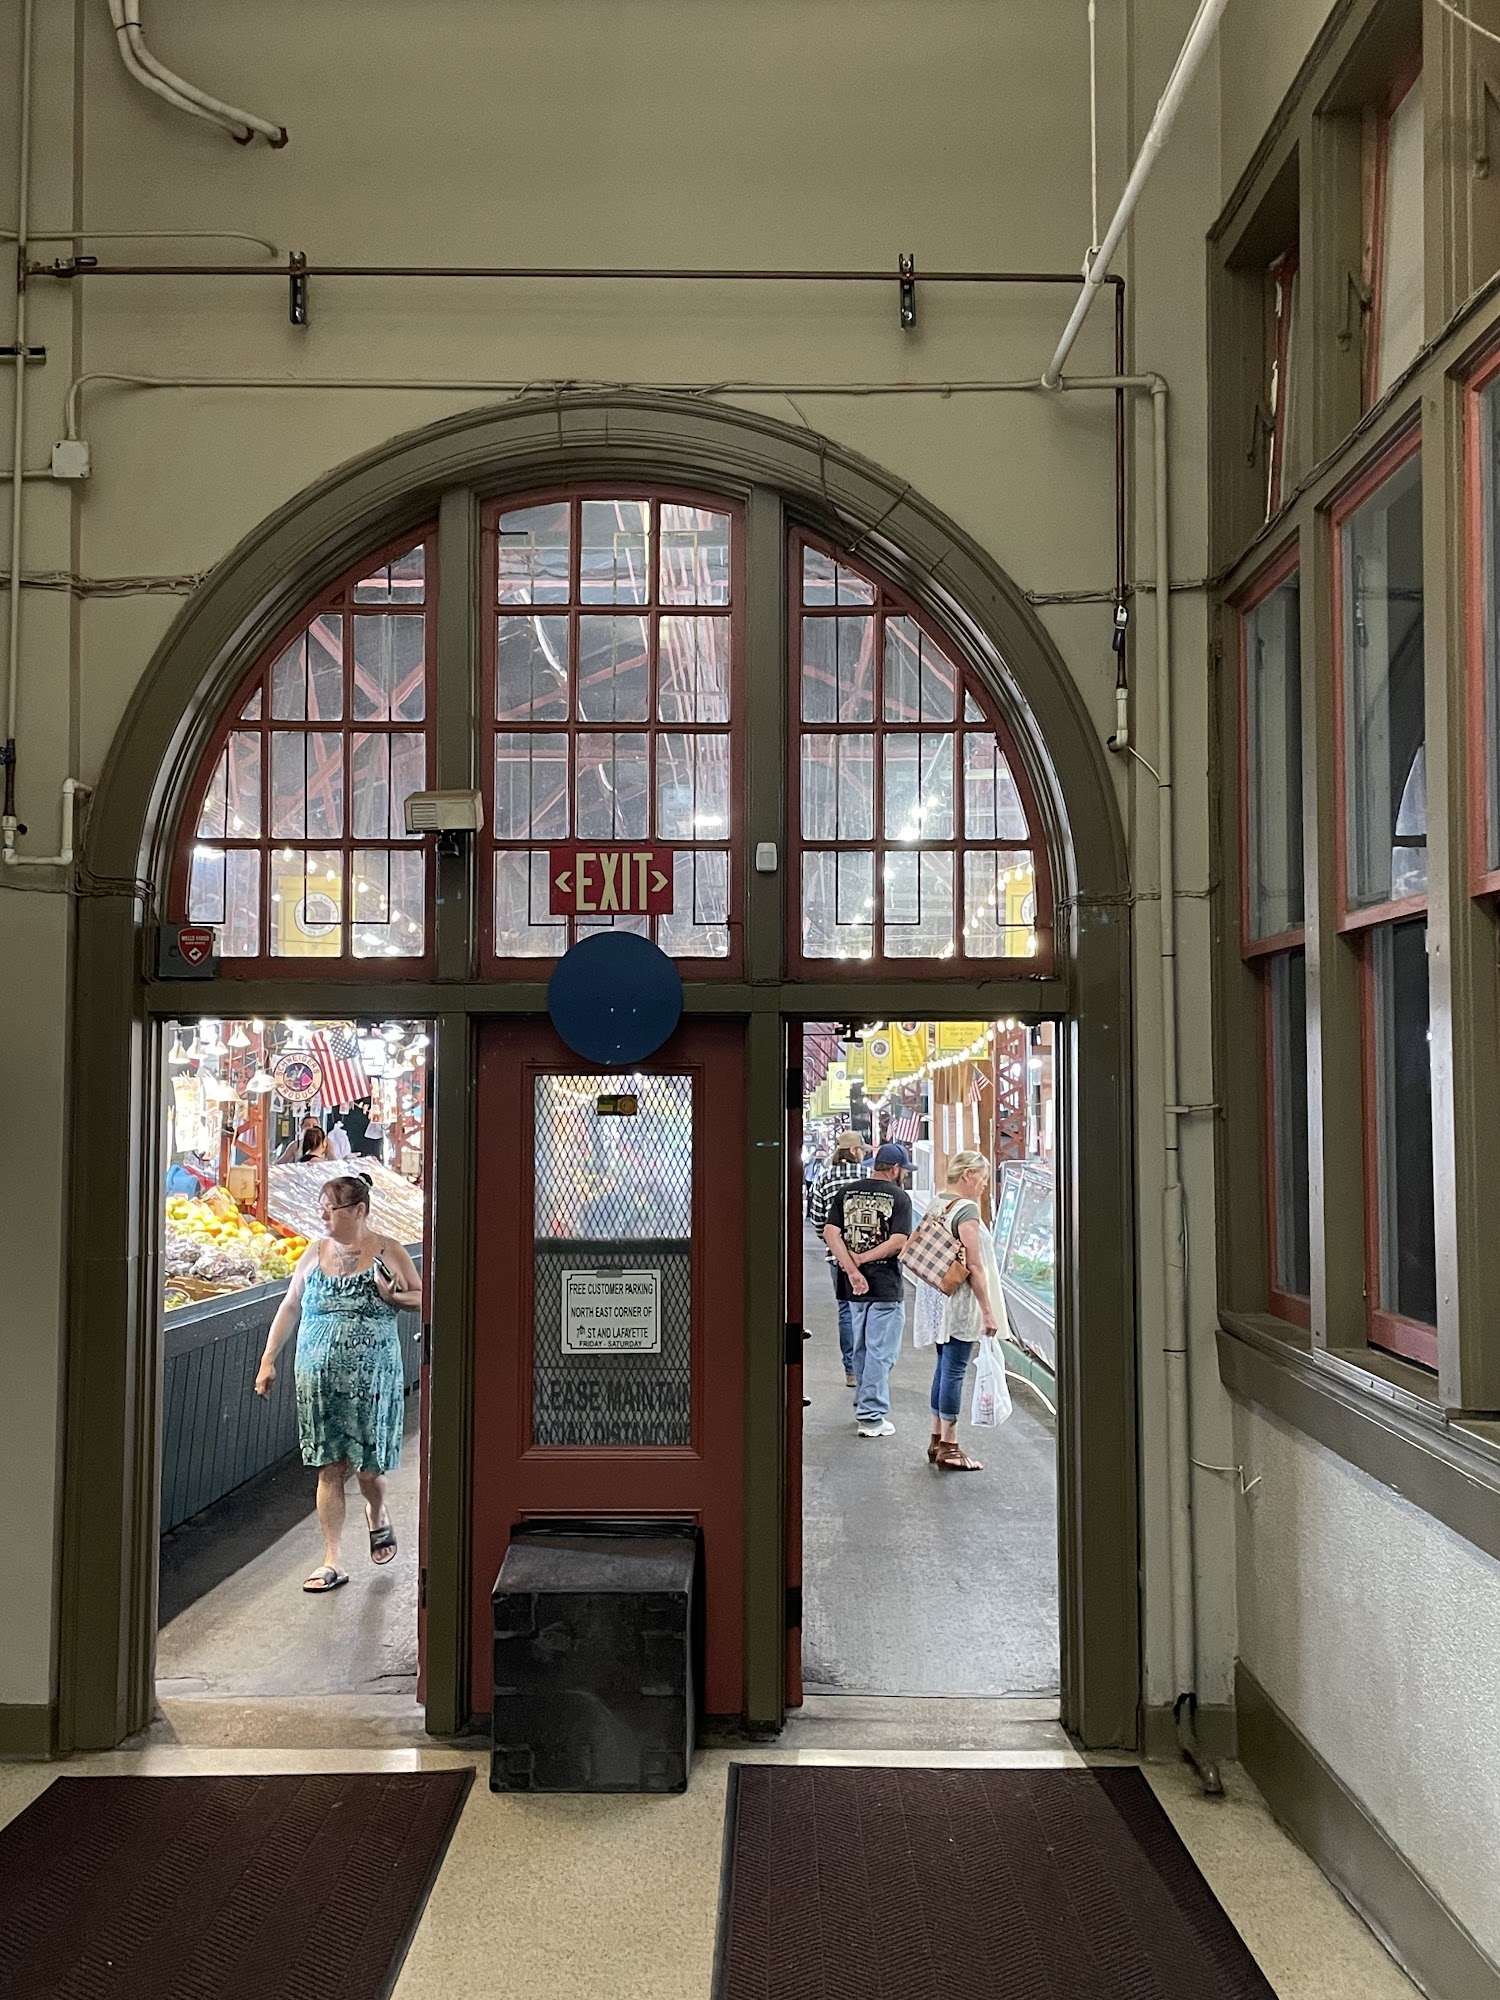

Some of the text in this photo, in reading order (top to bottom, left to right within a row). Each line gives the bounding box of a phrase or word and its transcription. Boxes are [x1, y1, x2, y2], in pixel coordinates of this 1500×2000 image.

[576, 853, 653, 911] EXIT
[275, 1055, 320, 1076] SCHWEIGERS
[276, 1083, 318, 1100] PRODUCE
[570, 1283, 653, 1295] FREE CUSTOMER PARKING
[571, 1306, 653, 1318] NORTH EAST CORNER OF
[597, 1327, 611, 1338] AND
[612, 1327, 648, 1338] LAFAYETTE
[535, 1380, 601, 1411] LEASE
[593, 1420, 690, 1444] DISTANCIN
